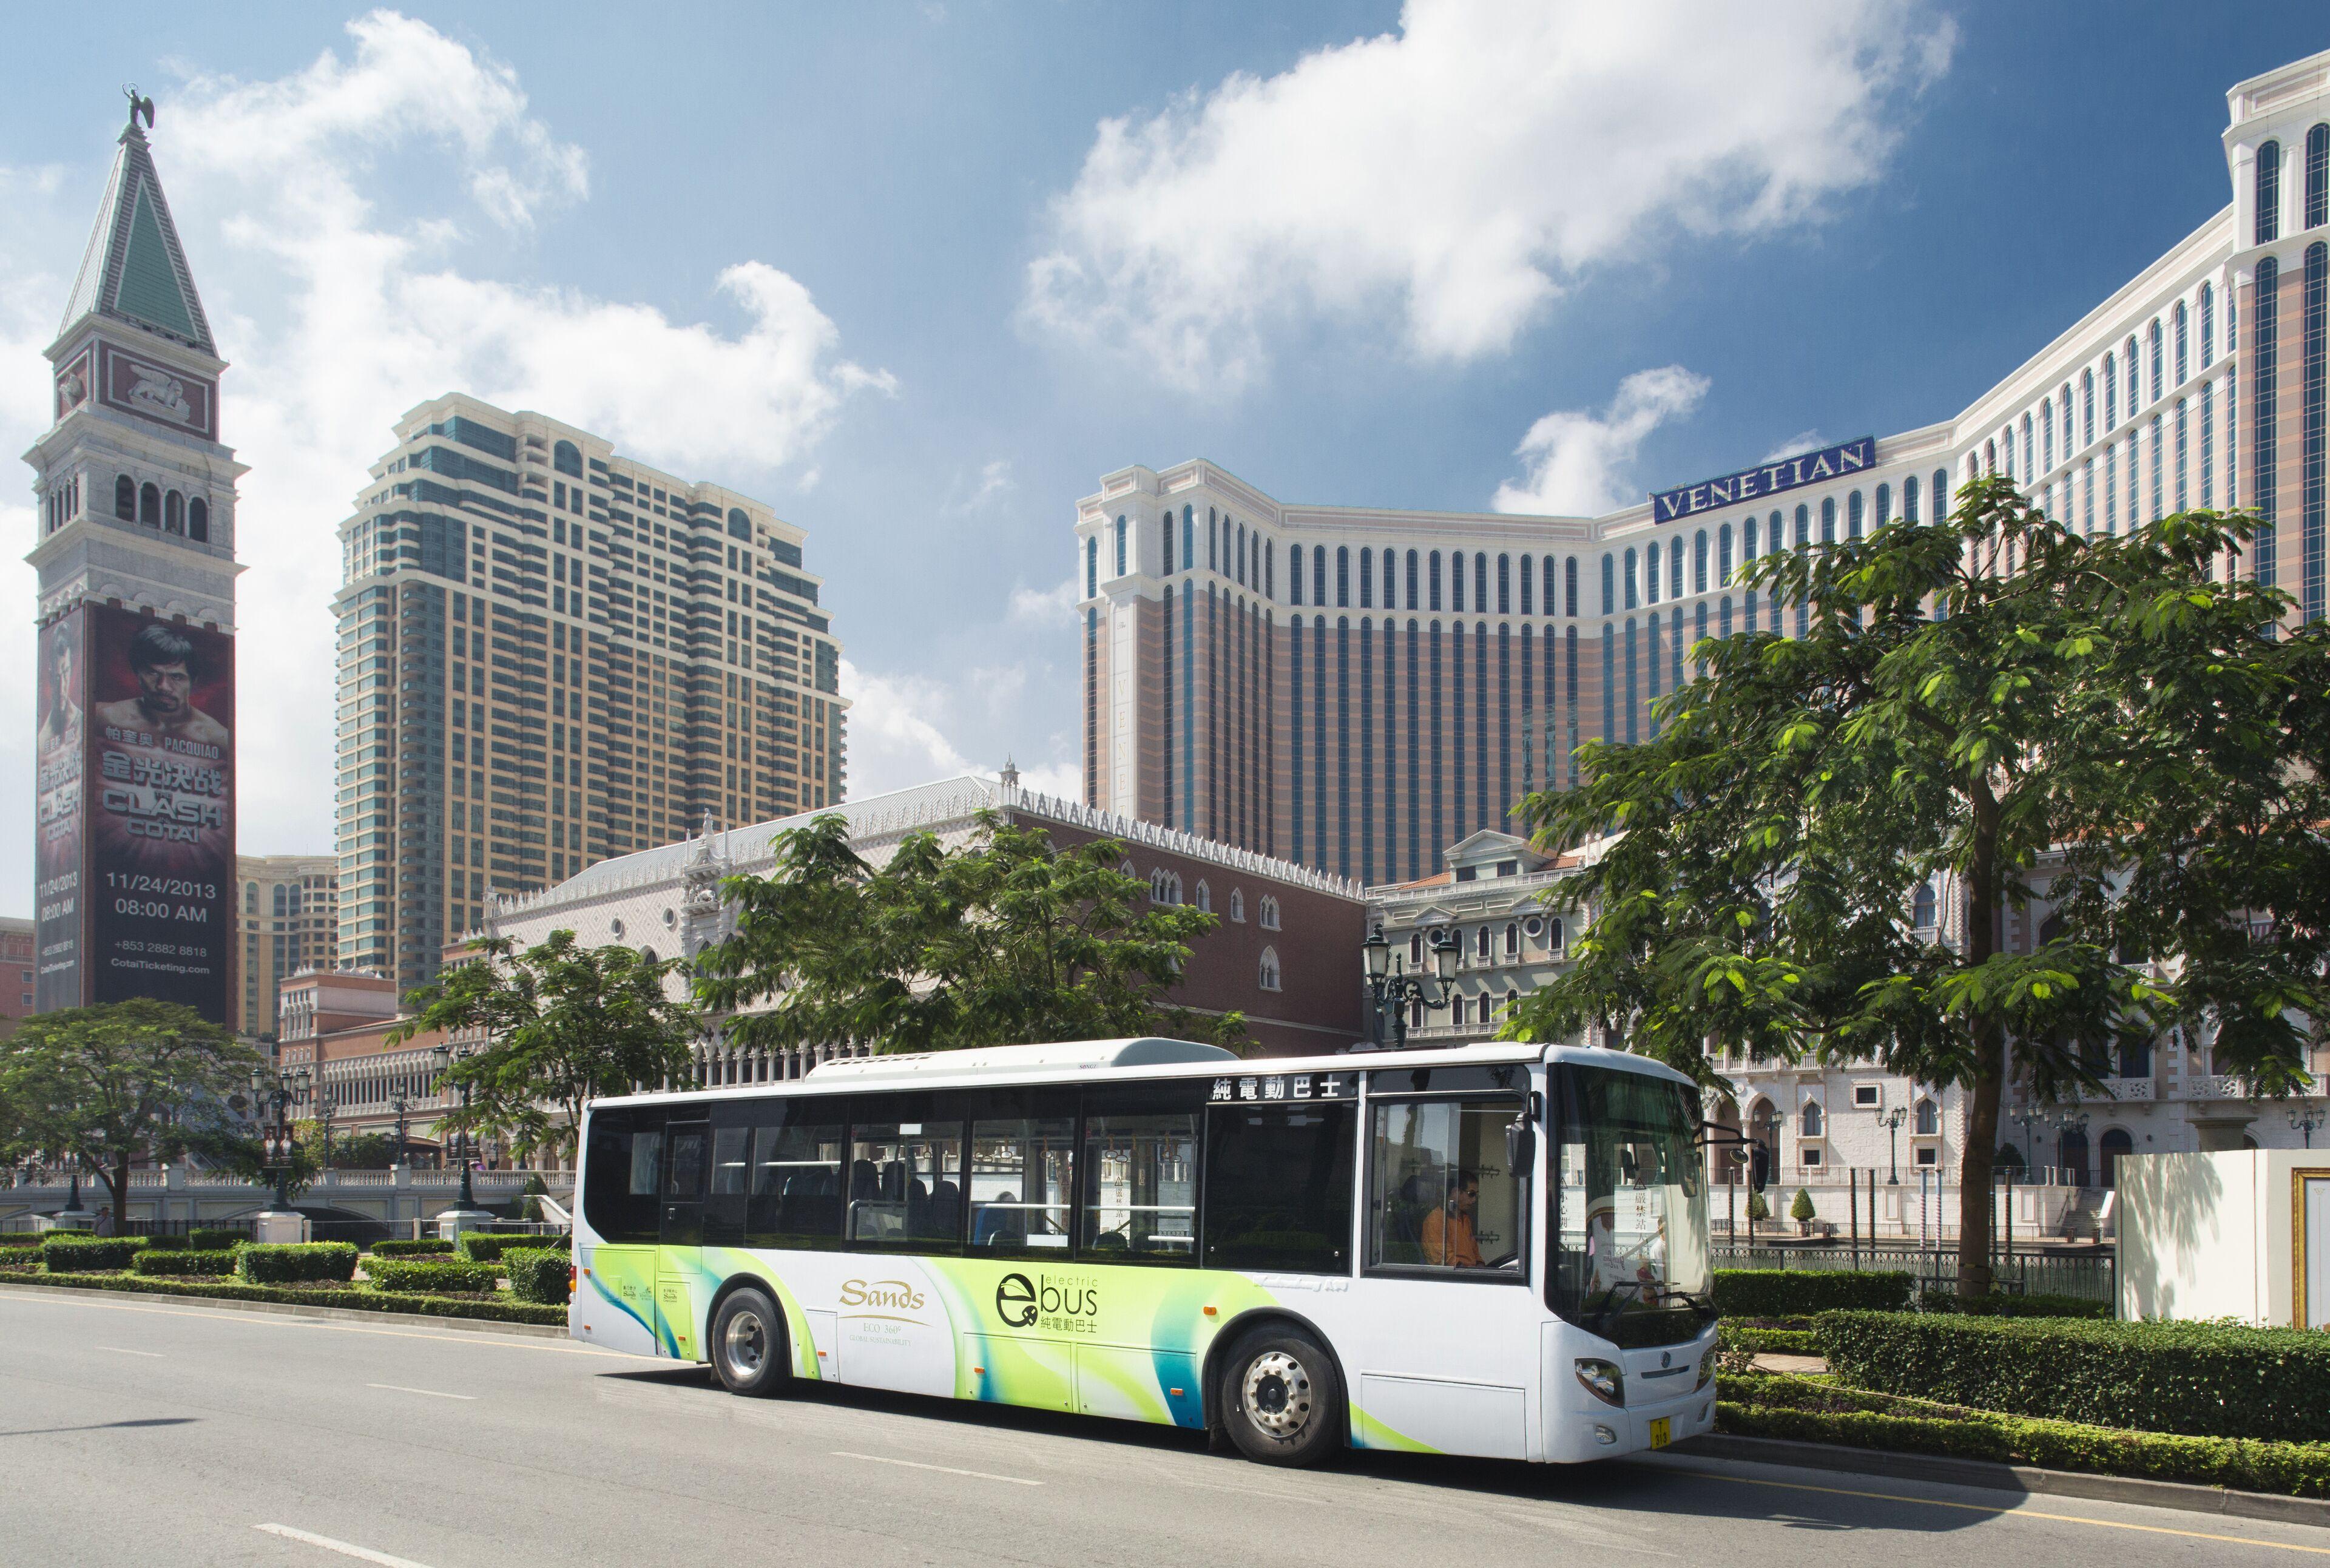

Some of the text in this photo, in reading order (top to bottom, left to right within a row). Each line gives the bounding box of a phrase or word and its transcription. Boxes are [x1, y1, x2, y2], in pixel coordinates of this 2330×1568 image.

[1660, 442, 1866, 517] VENETIAN
[164, 737, 219, 759] PACQUIAO
[102, 750, 222, 796] 金光决战
[39, 788, 79, 824] CLASH
[155, 791, 173, 799] THE
[102, 789, 222, 827] CLASH
[126, 817, 200, 843] COTAI
[40, 871, 78, 898] 11/24/2013
[107, 872, 216, 899] 11/24/2013
[42, 897, 75, 922] 08:00 AM
[115, 898, 207, 922] 08:00 AM
[115, 941, 207, 957] +853 2882 8818
[111, 958, 210, 974] CotaiTicketing.com
[1212, 1075, 1340, 1100] 純電動巴士
[1045, 1272, 1098, 1286] electric
[839, 1280, 925, 1309] Sands
[863, 1323, 880, 1333] ECO
[1041, 1316, 1098, 1333] 純電動巴士
[870, 1336, 911, 1347] SUSTAINABILITY
